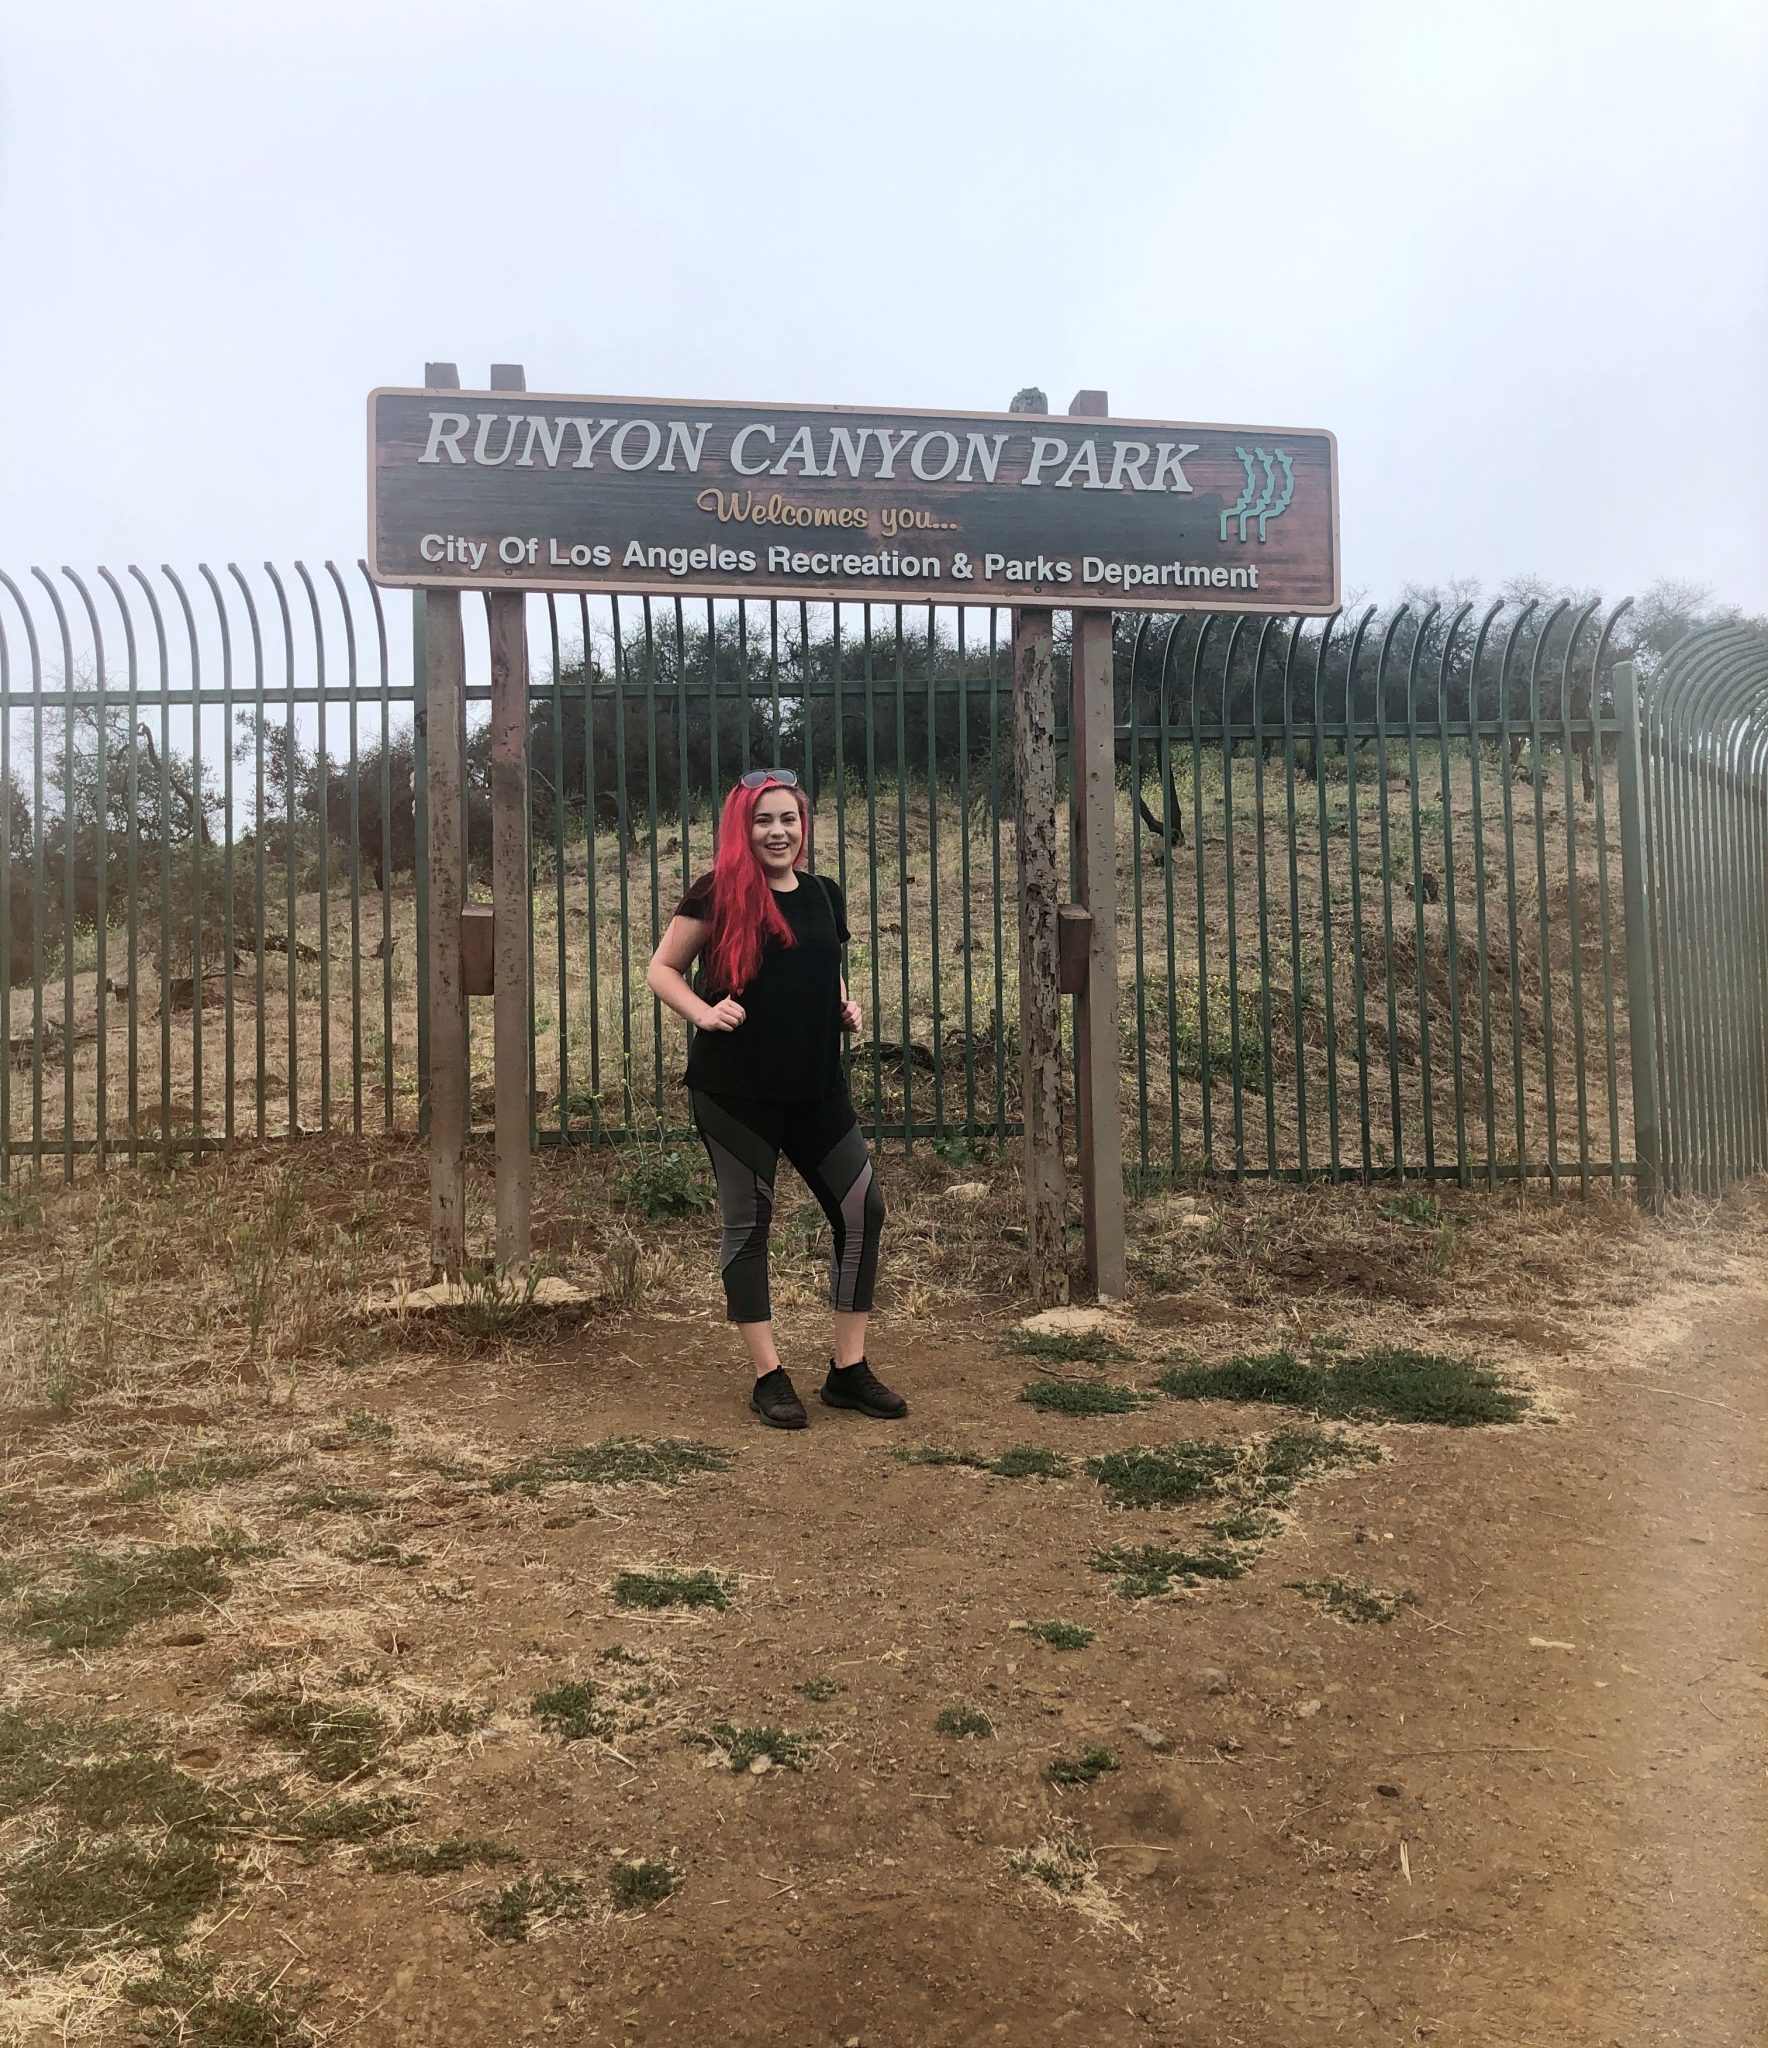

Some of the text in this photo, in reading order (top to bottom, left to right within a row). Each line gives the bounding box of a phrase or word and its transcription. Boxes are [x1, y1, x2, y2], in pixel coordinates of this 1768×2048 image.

[417, 411, 1200, 493] RUNYON CANYON PARK
[696, 487, 958, 538] Welcomes you...
[419, 533, 1260, 591] City Of Los Angeles Recreation & Parks Department
